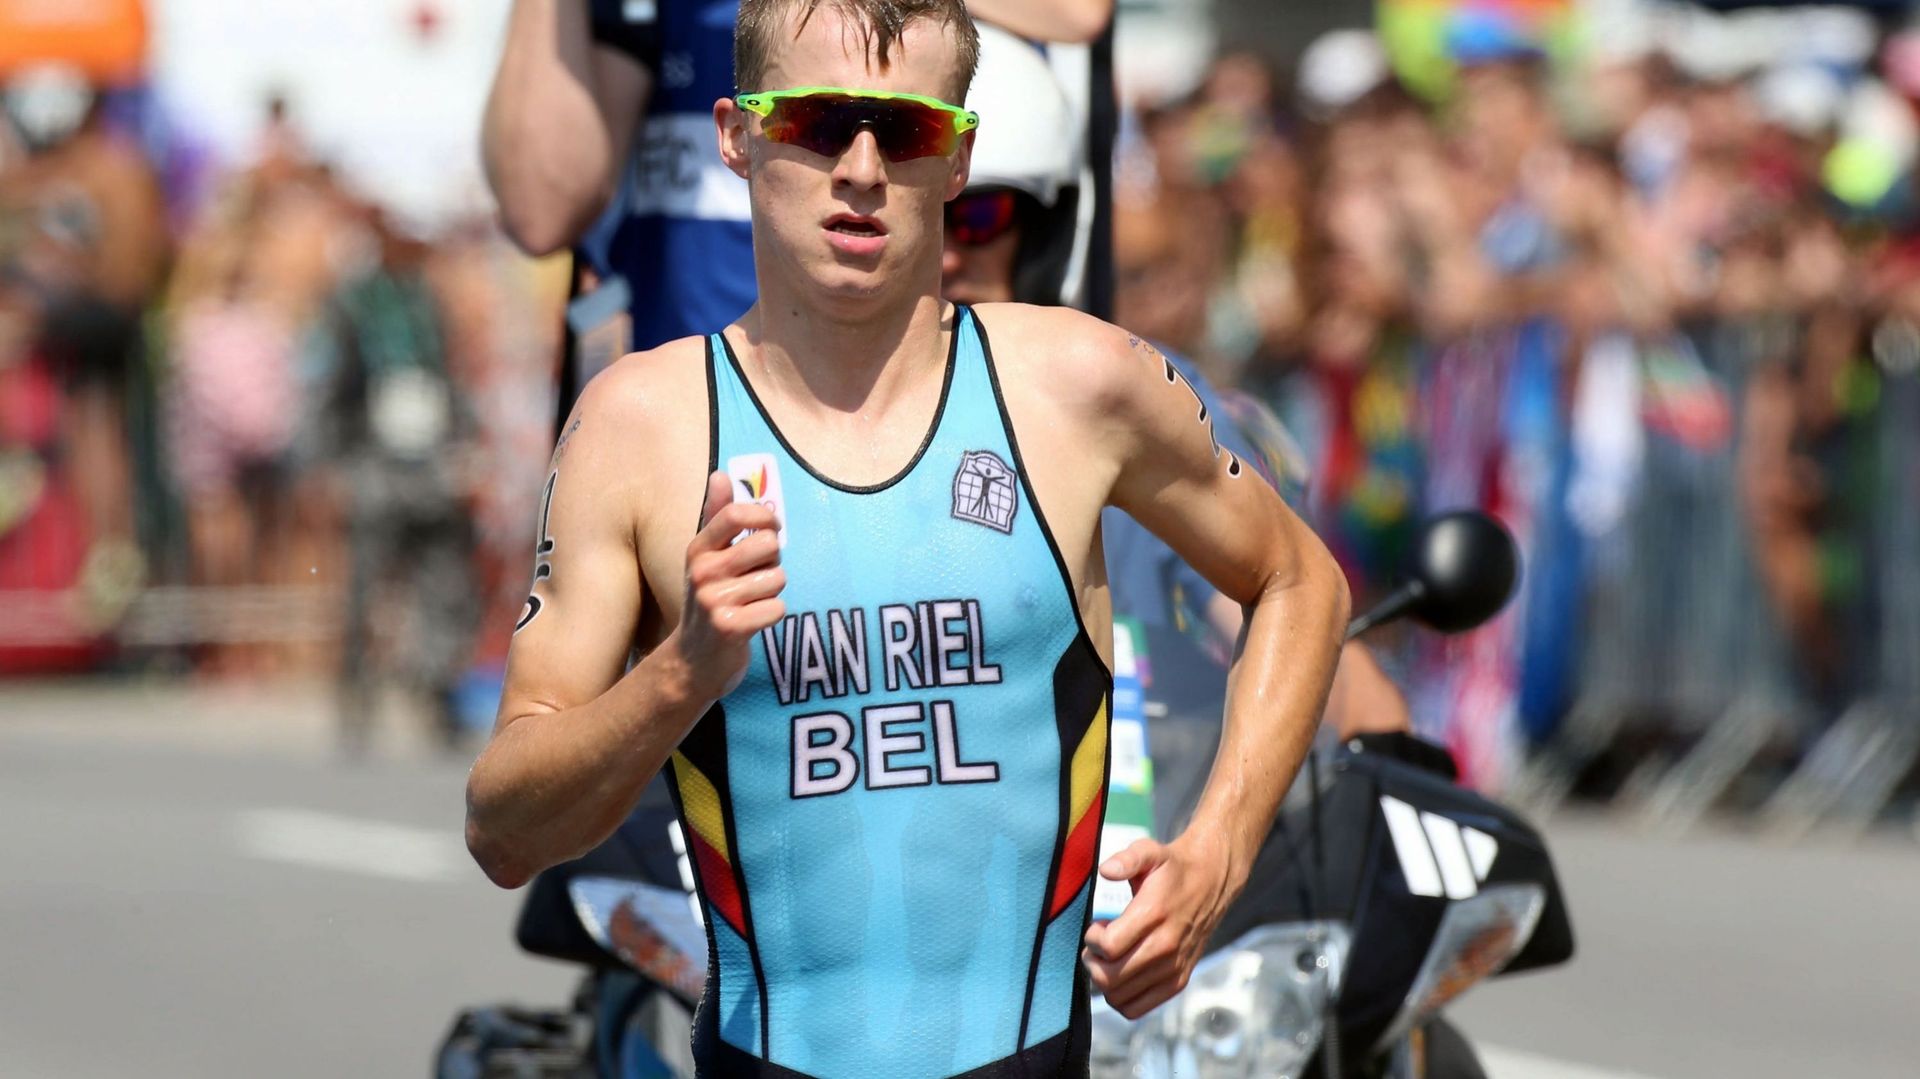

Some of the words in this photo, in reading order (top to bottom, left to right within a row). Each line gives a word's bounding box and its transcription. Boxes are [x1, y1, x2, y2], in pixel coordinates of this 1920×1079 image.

[761, 607, 870, 706] VAN
[879, 598, 1003, 691] RIEL
[790, 700, 1000, 799] BEL
